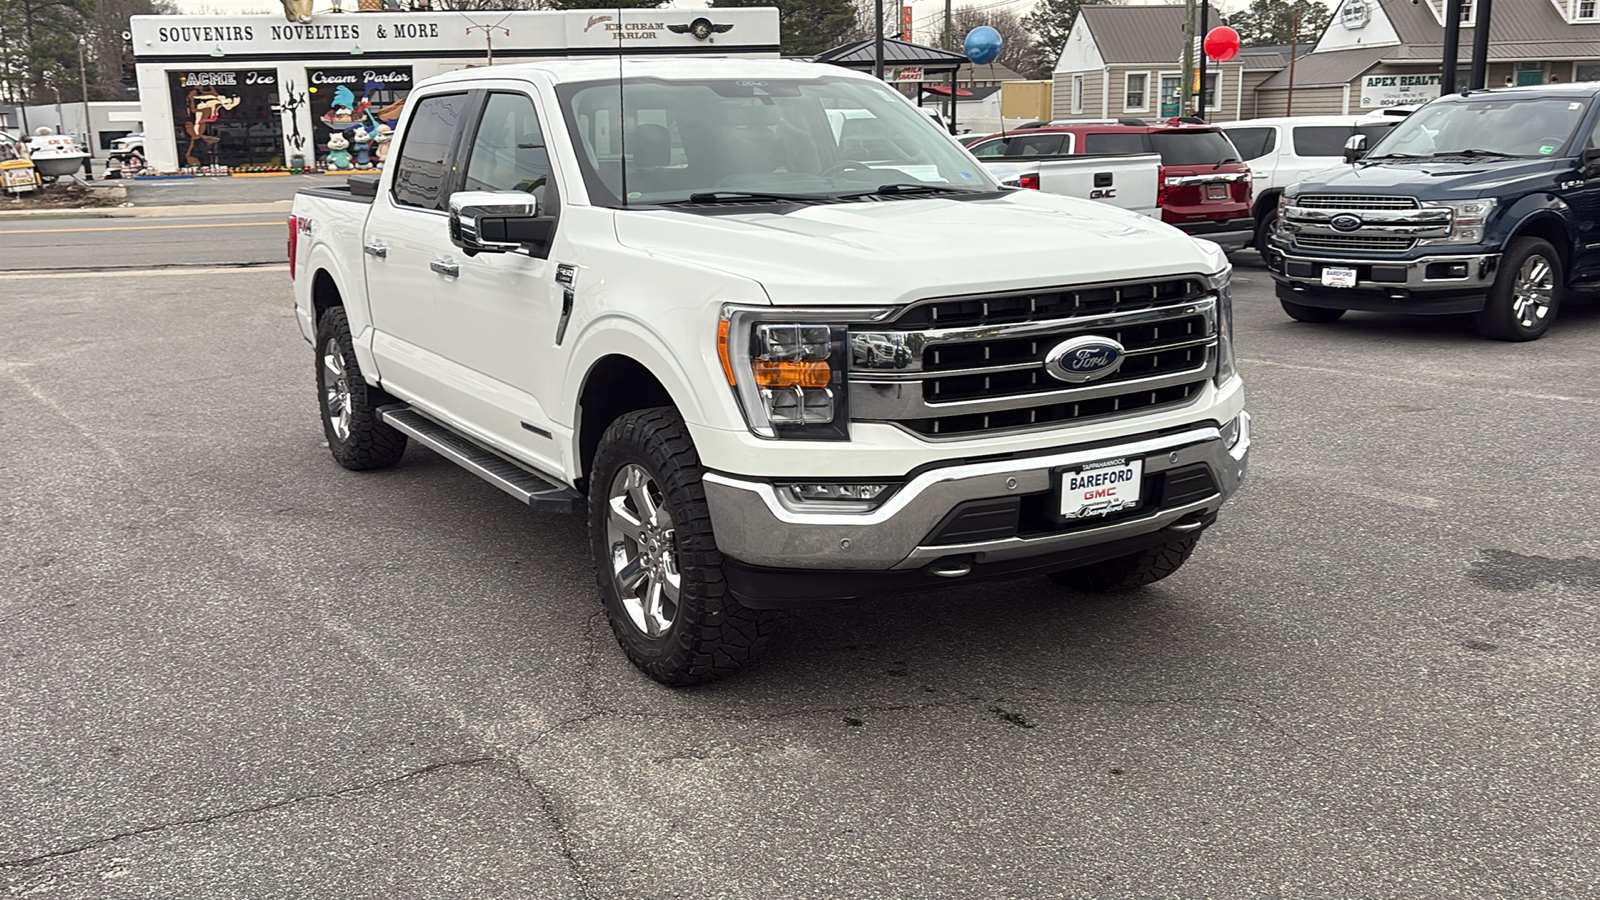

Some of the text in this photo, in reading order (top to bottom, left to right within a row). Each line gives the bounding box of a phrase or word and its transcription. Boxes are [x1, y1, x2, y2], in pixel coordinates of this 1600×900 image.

[159, 23, 439, 42] SOUVENIRS NOVELTIES & MORE
[604, 23, 622, 31] ICE
[624, 22, 665, 31] CREAM
[612, 31, 657, 39] PARLOR
[185, 71, 276, 86] ACME Ice
[311, 70, 411, 85] Cream Parlor
[1366, 75, 1442, 87] APEX REALTY
[1090, 188, 1117, 199] GMC
[1072, 348, 1109, 369] Ford
[1082, 458, 1126, 471] TAPPAHANNOCK
[1070, 468, 1133, 491] BAREFORD
[1084, 487, 1117, 500] GMC
[1077, 500, 1126, 517] Bareford
